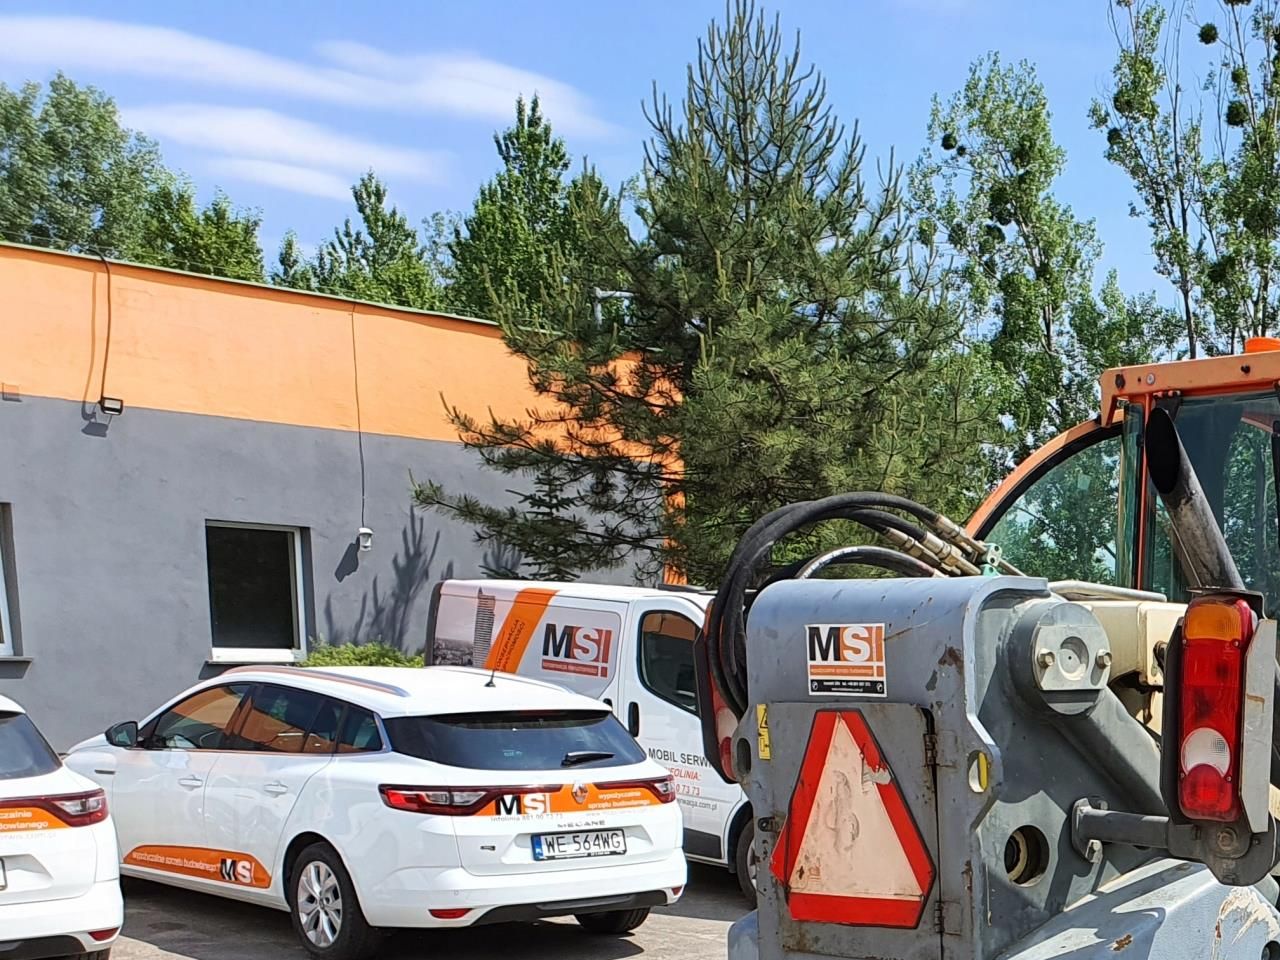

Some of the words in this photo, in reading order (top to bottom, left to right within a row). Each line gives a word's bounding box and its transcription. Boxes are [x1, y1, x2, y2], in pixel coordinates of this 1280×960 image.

[808, 626, 884, 662] MSI
[648, 748, 678, 763] MOBIL
[682, 785, 690, 795] 73
[692, 786, 700, 796] 73
[545, 836, 567, 853] WE
[573, 832, 621, 851] 564WG
